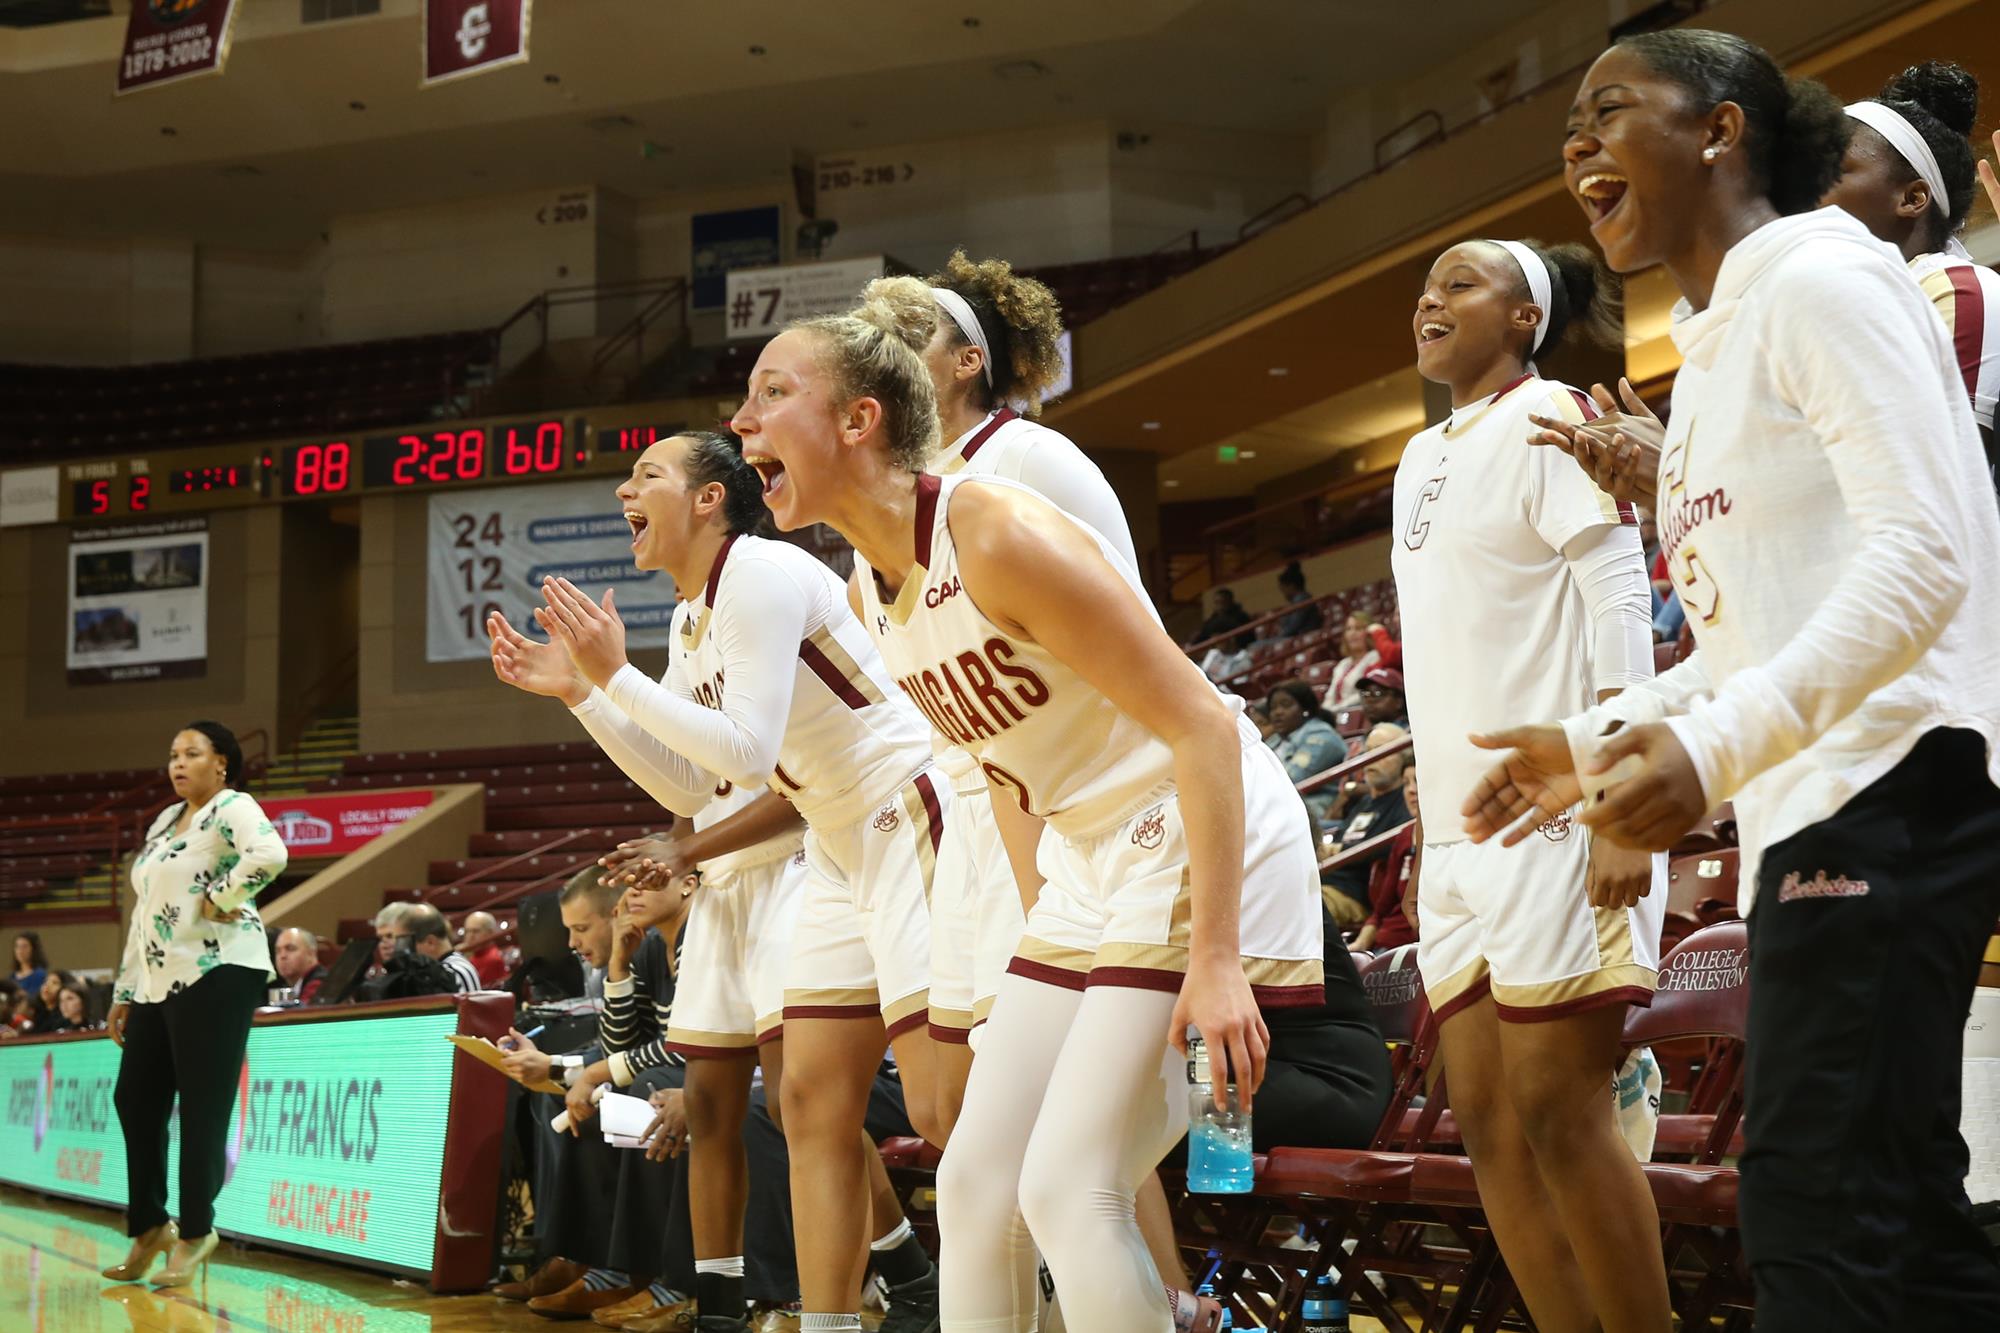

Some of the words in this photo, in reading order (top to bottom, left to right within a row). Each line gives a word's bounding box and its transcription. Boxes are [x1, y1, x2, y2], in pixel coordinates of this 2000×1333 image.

[731, 288, 781, 329] #7
[295, 443, 350, 495] 88
[392, 430, 485, 485] 2:28
[91, 481, 110, 514] 5
[130, 477, 150, 511] 2
[453, 512, 504, 548] 24
[1404, 476, 1447, 551] C
[458, 556, 504, 593] 12
[925, 575, 962, 609] CAA
[339, 809, 385, 825] LOCALLY
[1362, 968, 1411, 988] COLLEGE
[1672, 949, 1735, 971] COLLEGE
[1655, 966, 1749, 992] CHARLESTON
[246, 1078, 274, 1154] ST.
[276, 1077, 383, 1164] FRANCIS
[266, 1180, 372, 1243] HEALTHCARE
